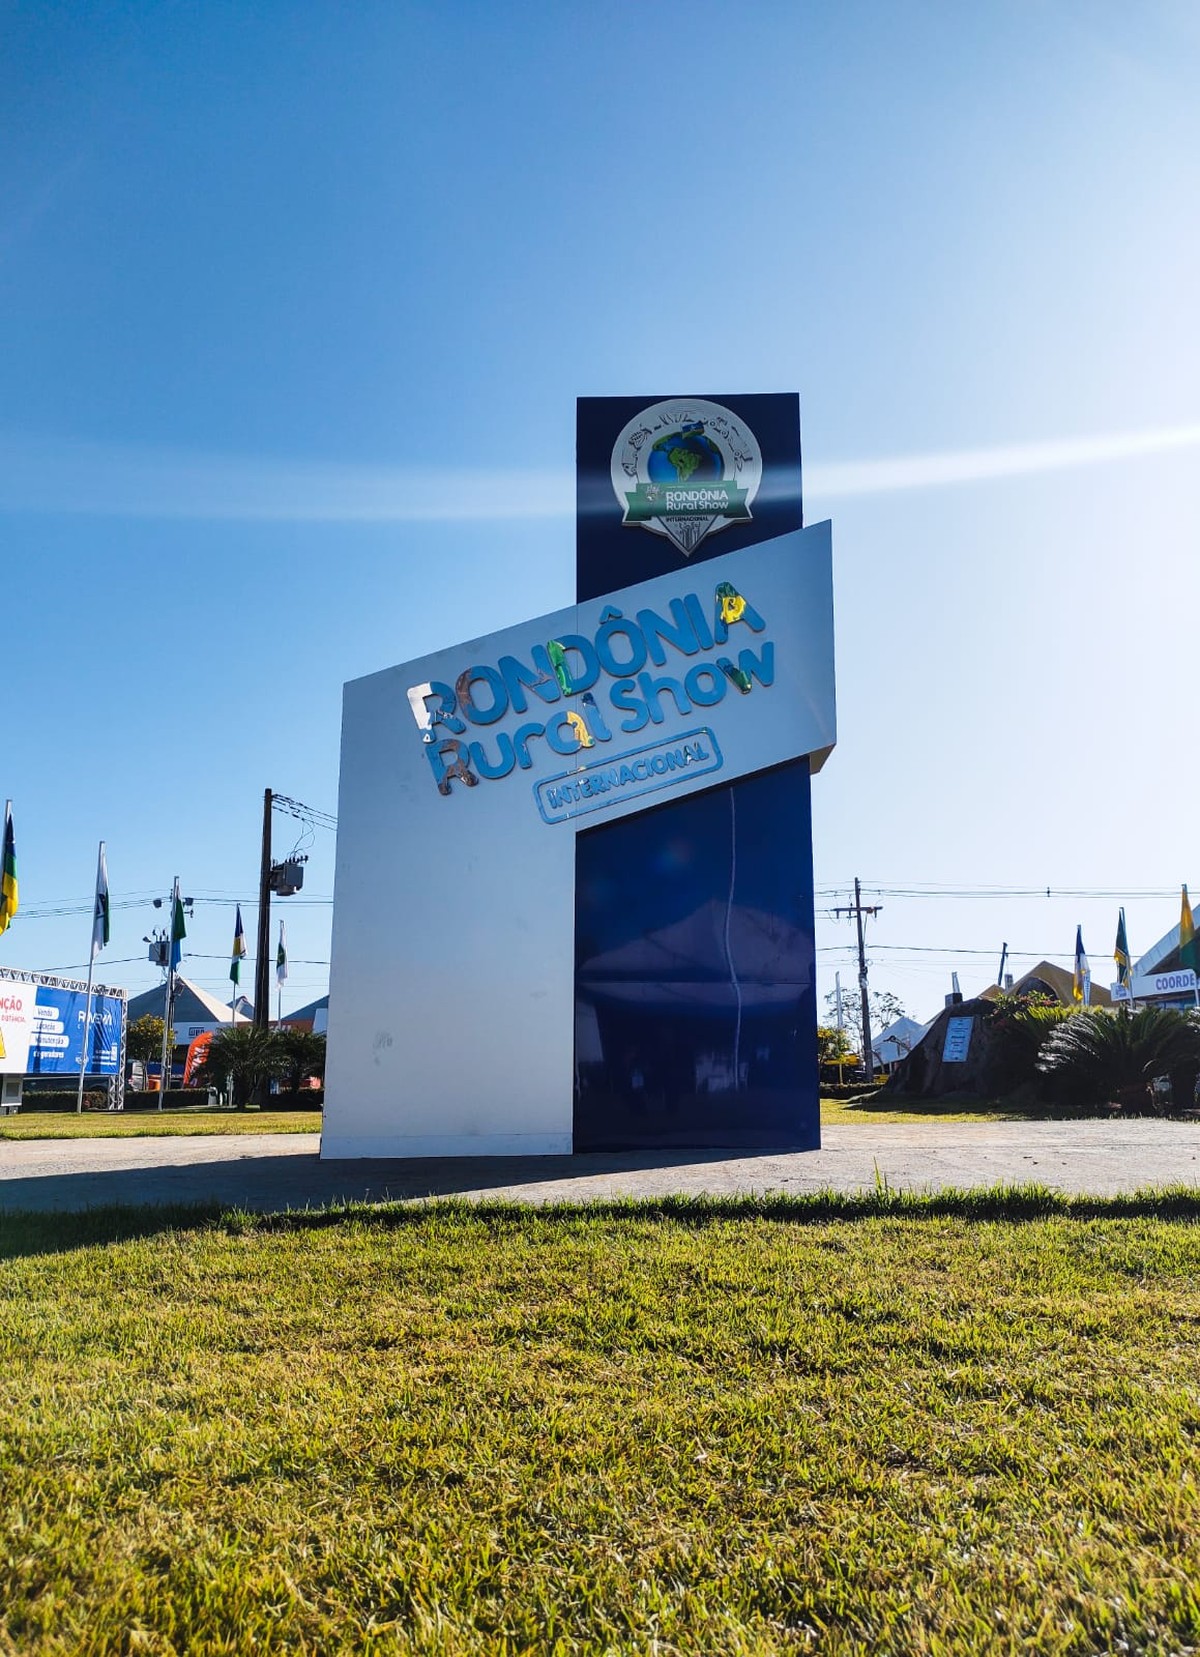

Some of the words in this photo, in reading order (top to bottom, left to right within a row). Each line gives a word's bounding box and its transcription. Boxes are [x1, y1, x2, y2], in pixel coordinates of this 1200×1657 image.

[666, 489, 728, 501] RONDÔNIA
[666, 501, 697, 511] Rural
[699, 501, 729, 510] Show
[406, 581, 766, 744] RONDÔNIA
[424, 692, 612, 796] Rural
[546, 741, 710, 809] INTERNACIONAL
